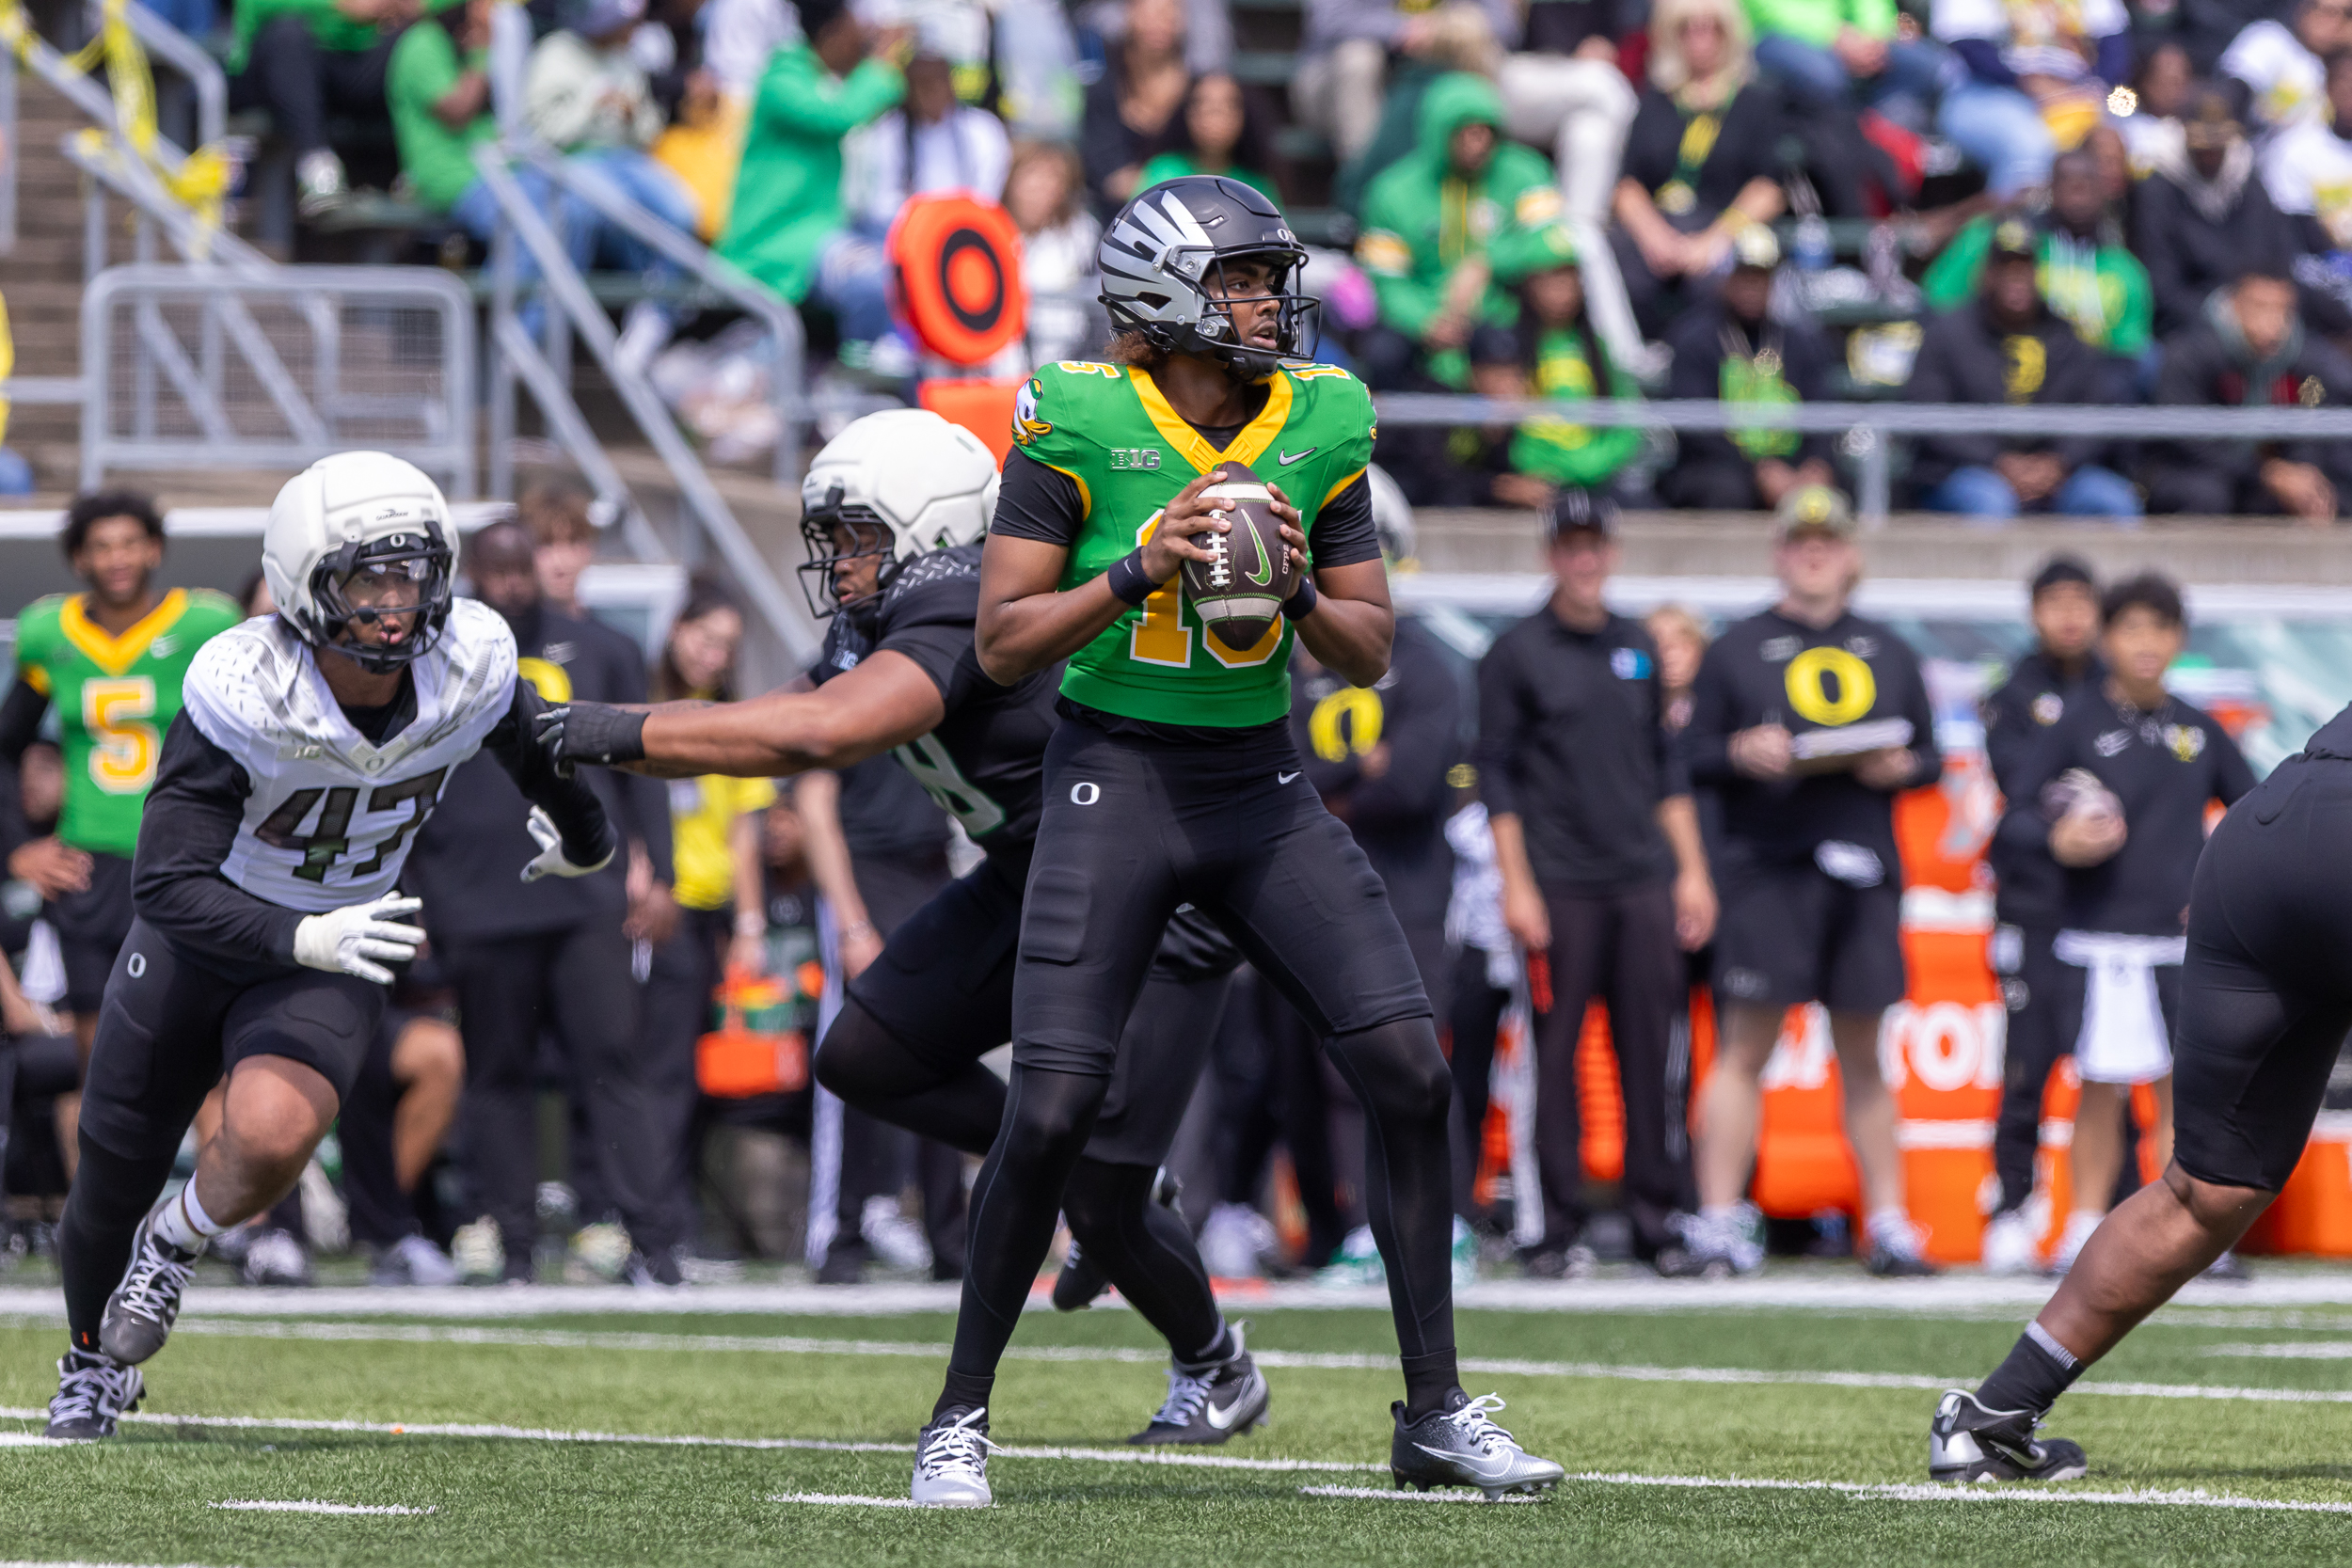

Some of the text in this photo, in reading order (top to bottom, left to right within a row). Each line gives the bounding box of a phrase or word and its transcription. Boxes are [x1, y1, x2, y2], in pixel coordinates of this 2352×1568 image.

[389, 533, 406, 548] O
[1783, 645, 1878, 727] O
[82, 675, 161, 795] 5
[1071, 782, 1101, 806] O
[253, 765, 450, 884] 47
[127, 952, 148, 979] O
